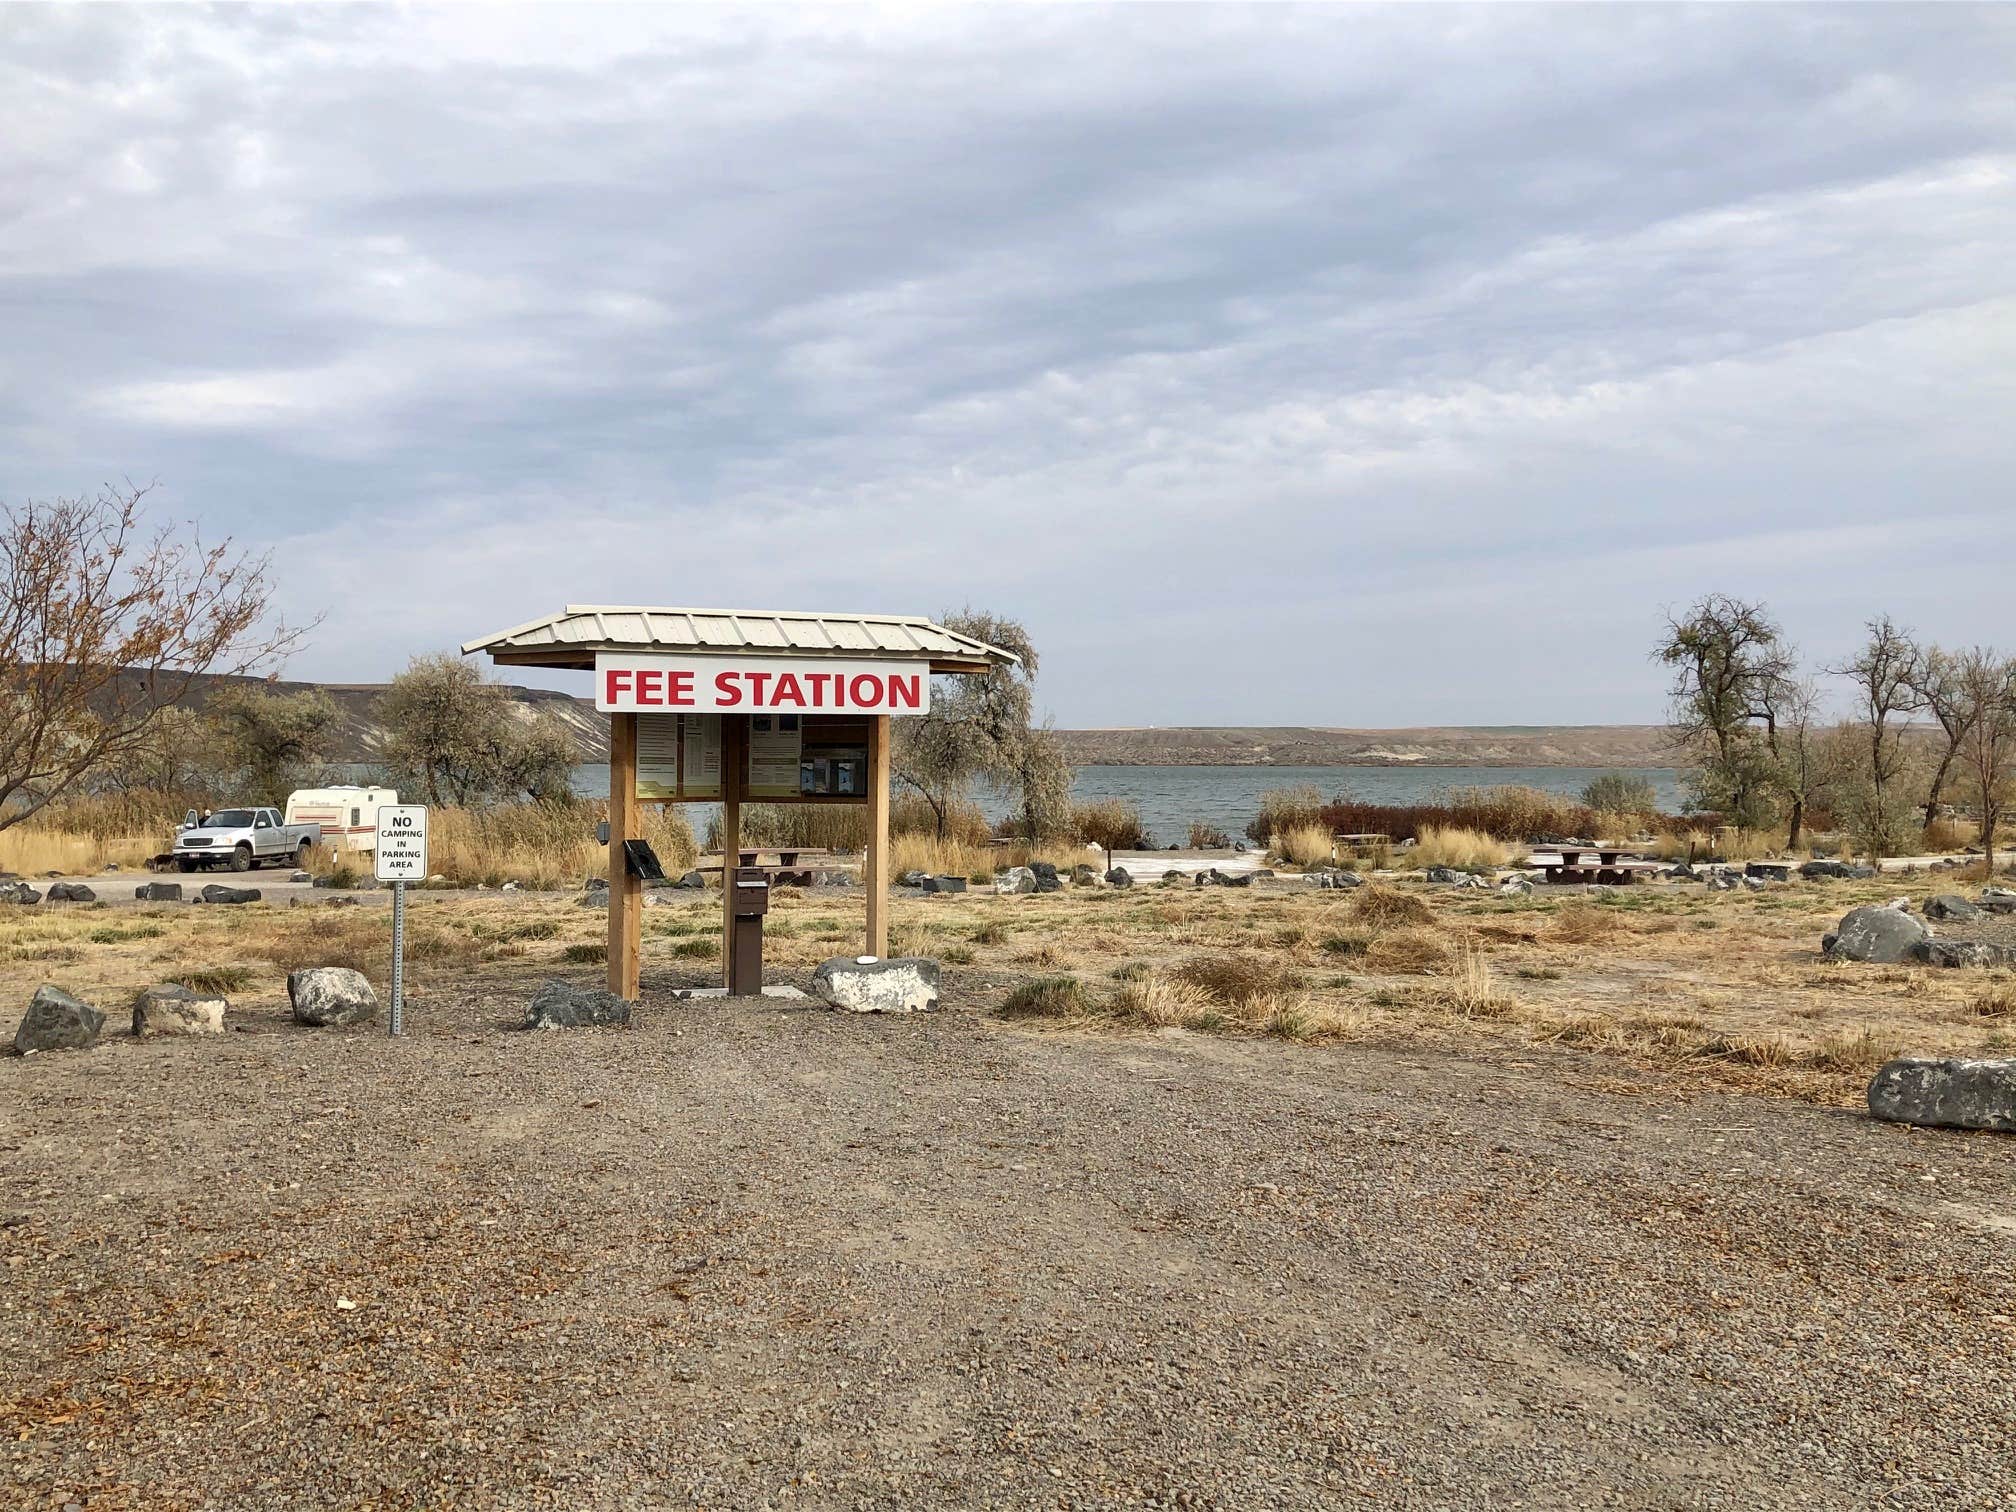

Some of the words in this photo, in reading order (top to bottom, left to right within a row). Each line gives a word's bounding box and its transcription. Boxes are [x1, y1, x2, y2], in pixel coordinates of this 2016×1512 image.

[606, 670, 695, 706] FEE
[714, 671, 921, 708] STATION
[392, 817, 412, 827] NO
[381, 830, 423, 838] CAMPING
[382, 850, 421, 858] PARKING
[389, 861, 413, 869] AREA
